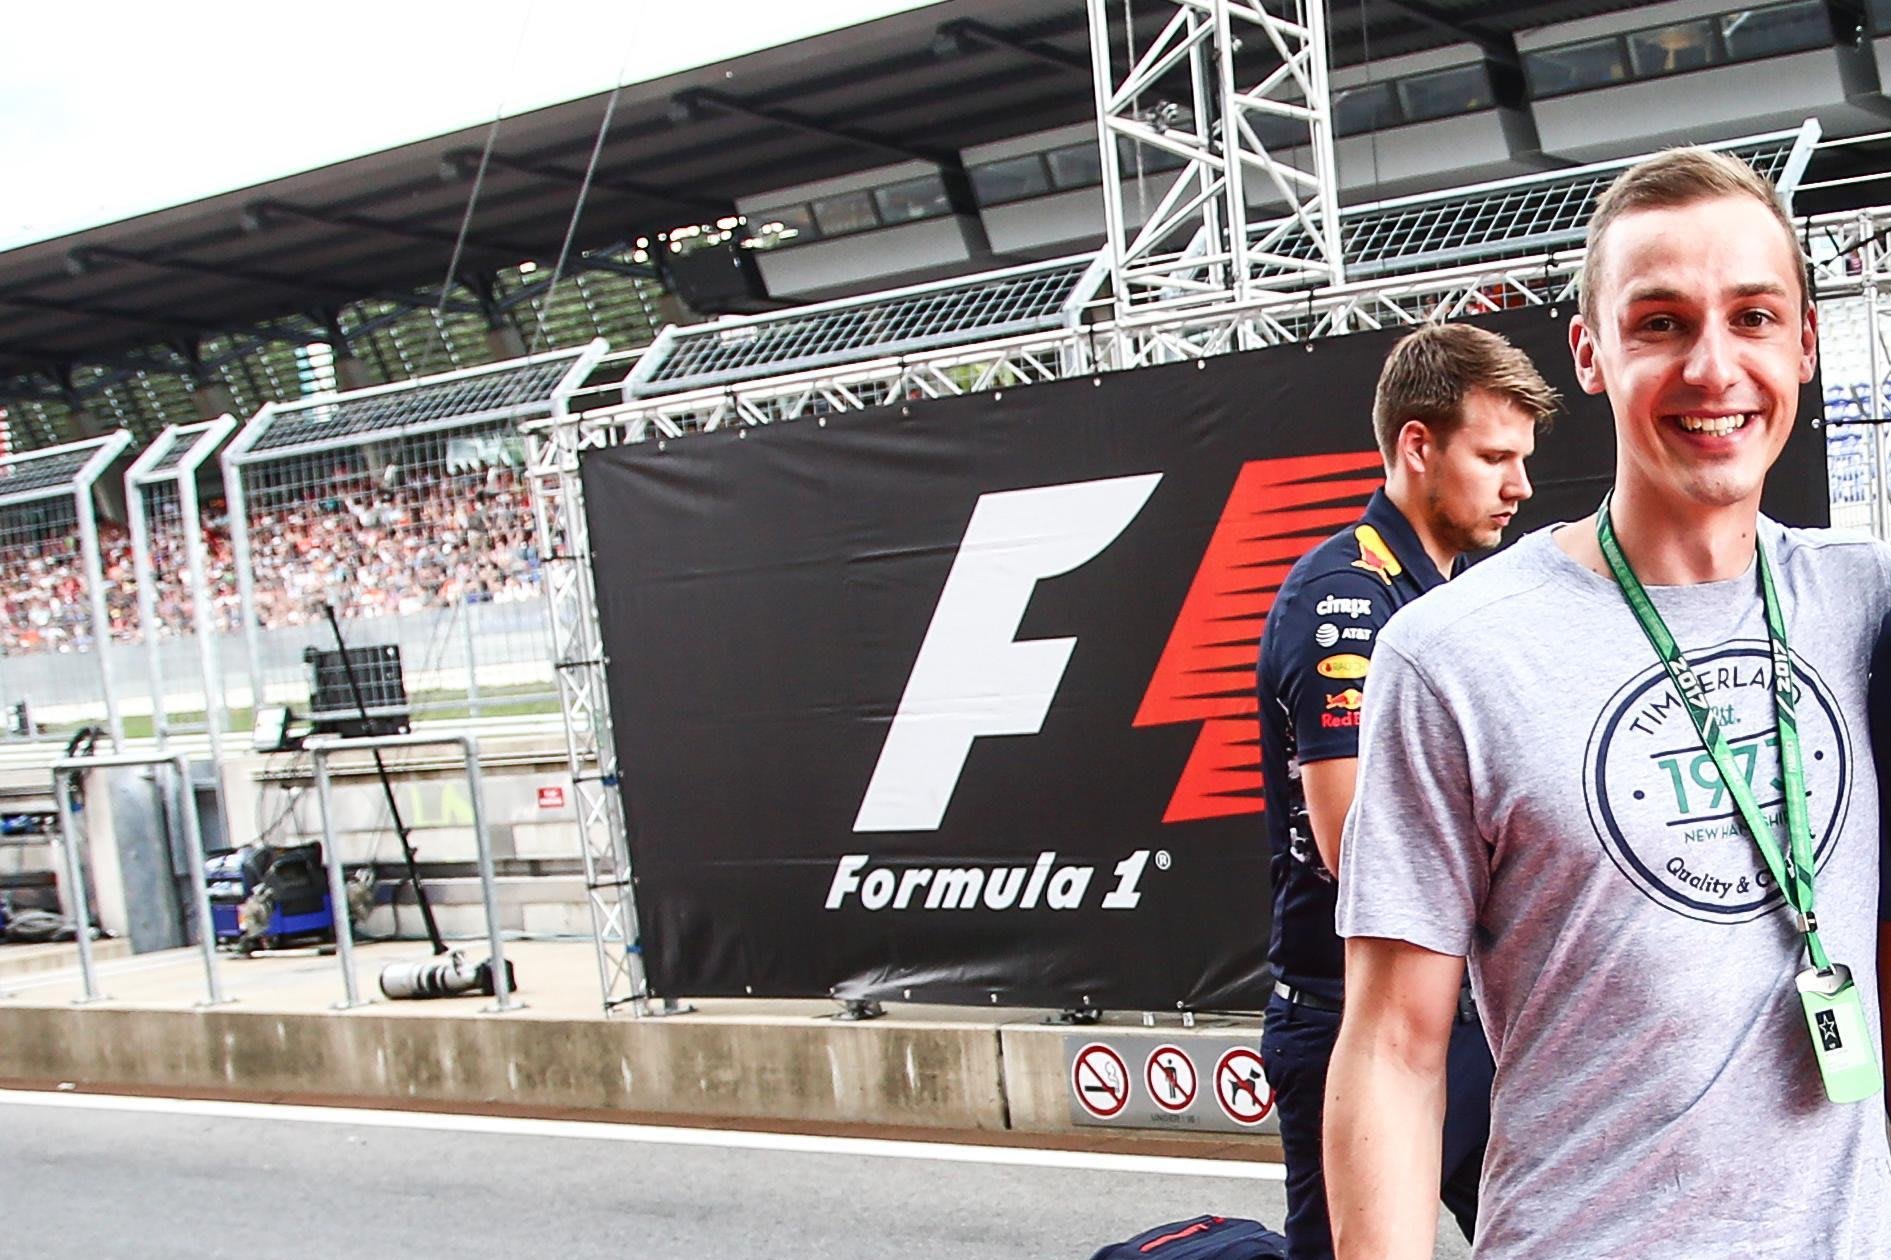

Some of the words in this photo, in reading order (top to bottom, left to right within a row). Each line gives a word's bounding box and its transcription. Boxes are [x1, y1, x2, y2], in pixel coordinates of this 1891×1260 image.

[1342, 627, 1373, 640] AT&T
[1629, 666, 1802, 735] TIMERLA
[1669, 656, 1710, 710] 2017
[1684, 828, 1720, 844] NEW
[824, 851, 1094, 910] Formula
[1666, 857, 1733, 899] Quality
[1736, 876, 1750, 894] &
